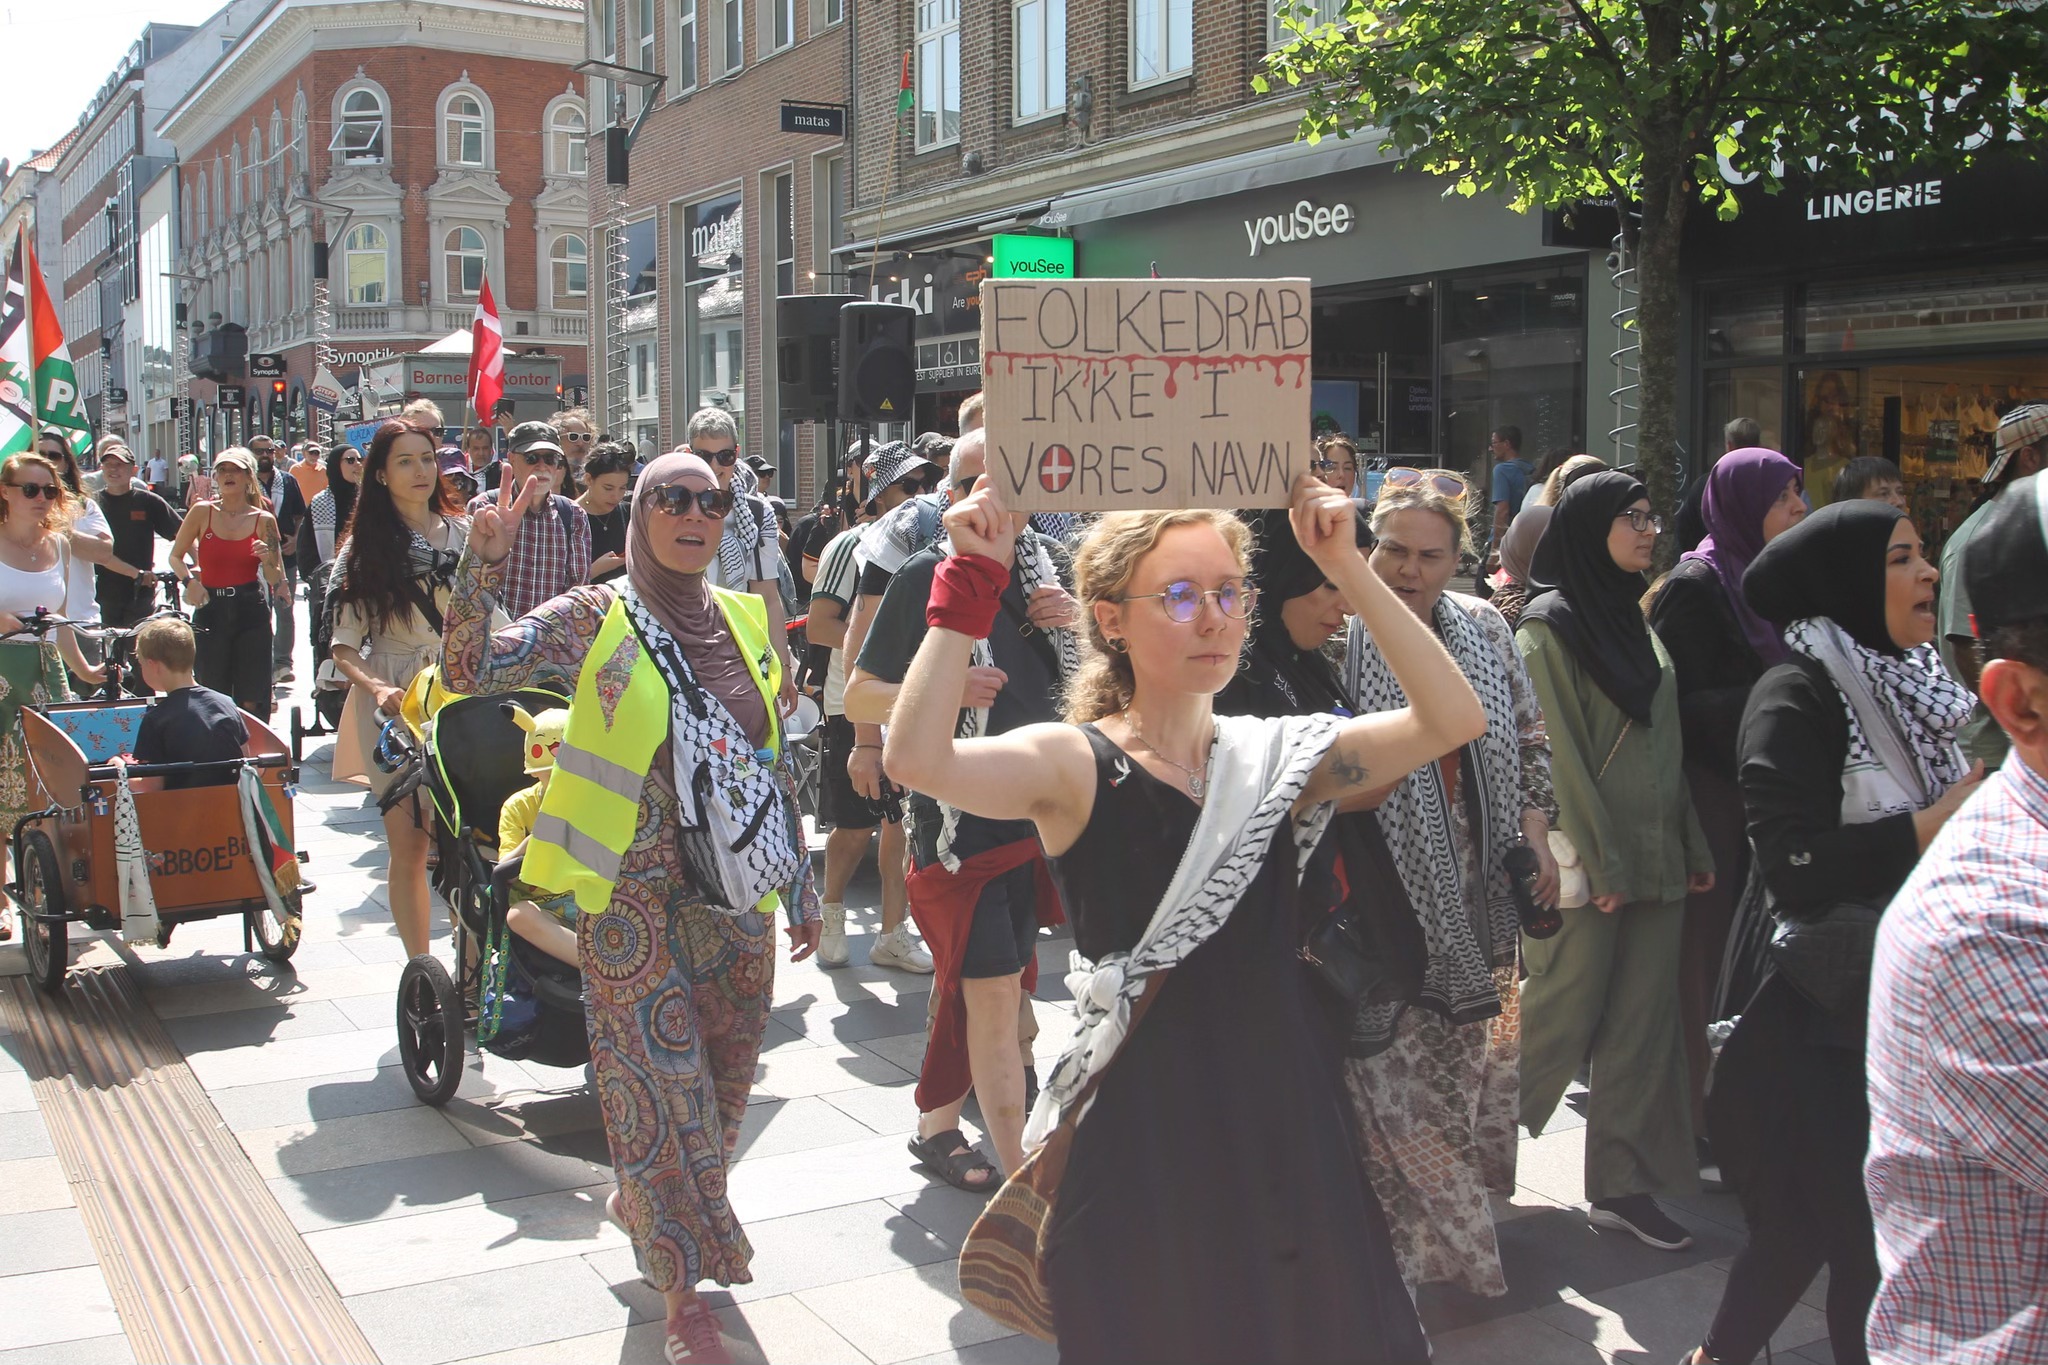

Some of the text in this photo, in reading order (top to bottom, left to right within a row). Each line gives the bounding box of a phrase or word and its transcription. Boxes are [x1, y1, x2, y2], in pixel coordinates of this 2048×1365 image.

[794, 115, 830, 128] matas
[1807, 180, 1942, 221] LINGERIE
[1039, 212, 1067, 225] youSee
[1244, 200, 1351, 257] youSee
[1010, 259, 1065, 275] youSee
[952, 296, 966, 310] Are
[993, 286, 1309, 353] FOLKEDRAB
[328, 348, 395, 367] Synoptik
[252, 368, 280, 376] Synoptik
[413, 370, 469, 385] Børne
[928, 368, 955, 380] SUPPLIER
[957, 367, 964, 375] IN
[966, 365, 981, 376] EURO
[1021, 365, 1229, 423] IKKE I
[998, 440, 1291, 496] VORES NAVN
[150, 845, 233, 877] BBOE
